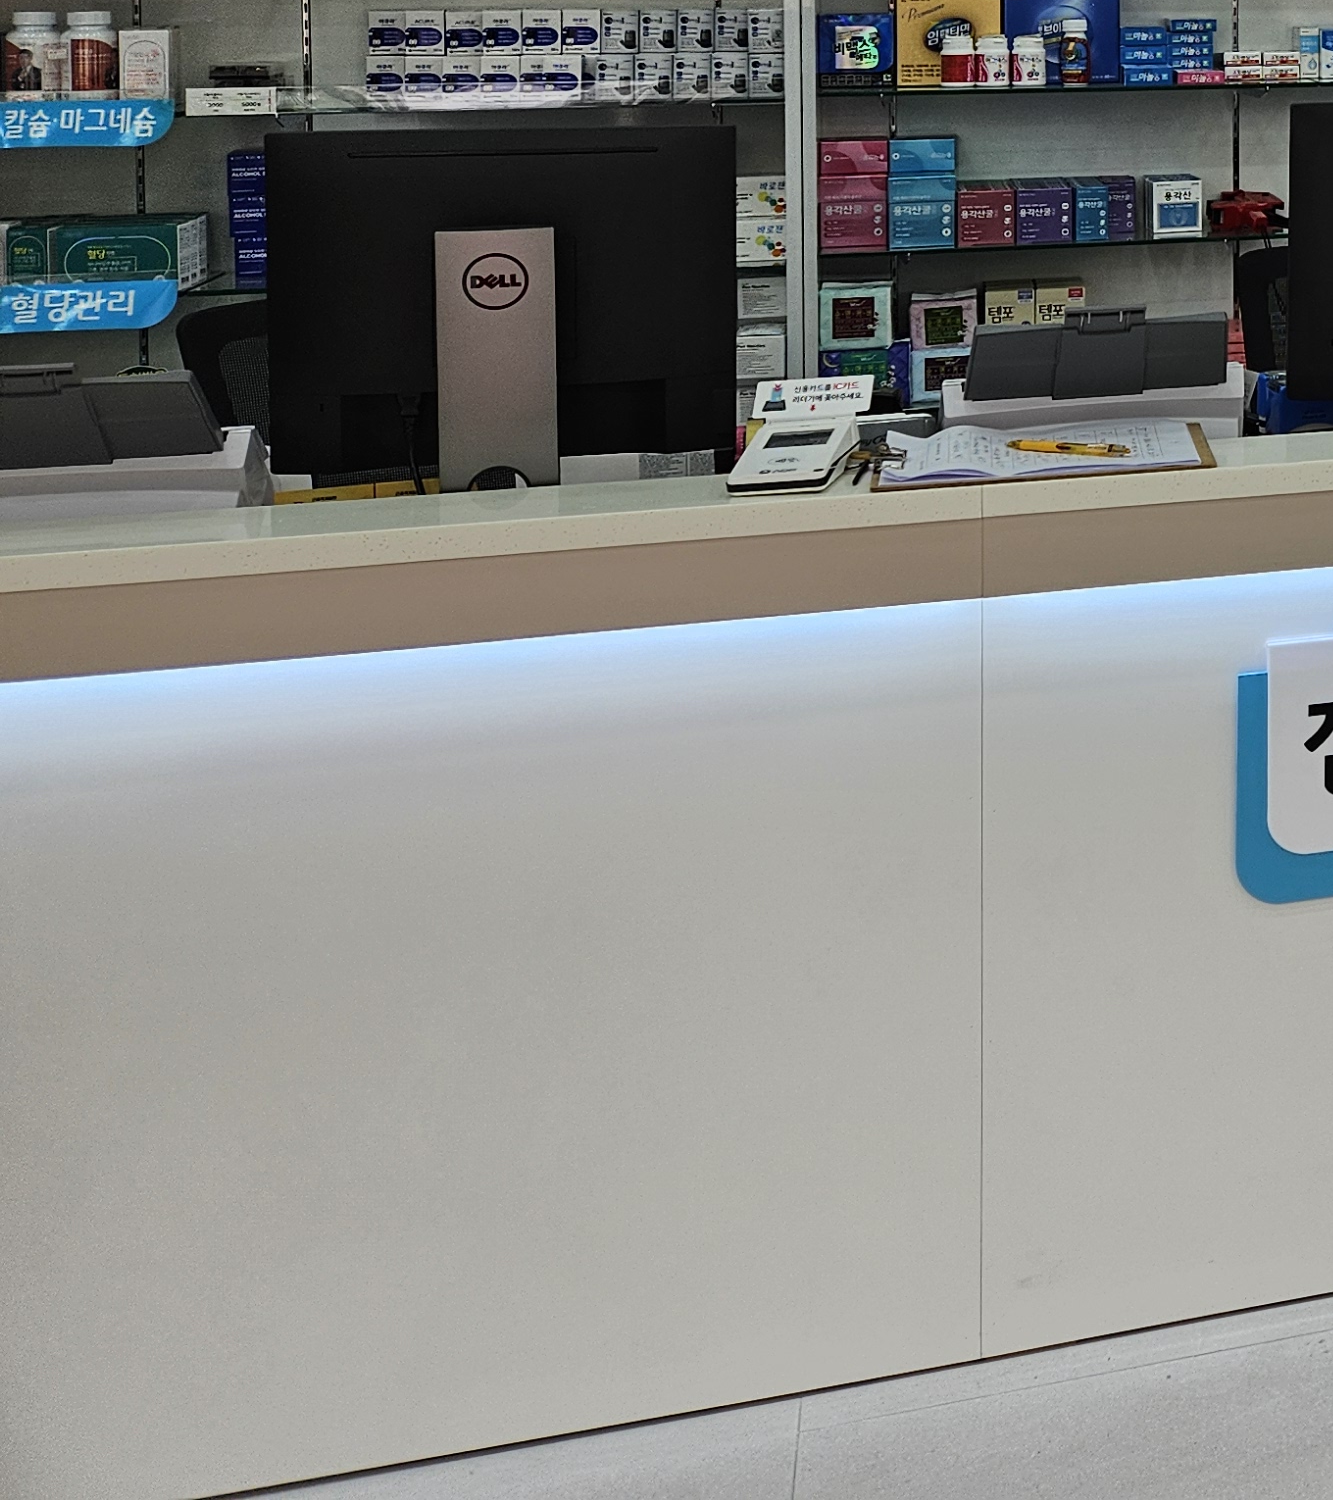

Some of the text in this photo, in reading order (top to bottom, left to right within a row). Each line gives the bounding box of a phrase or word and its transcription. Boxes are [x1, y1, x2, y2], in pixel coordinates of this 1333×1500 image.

[5, 108, 156, 139] 칼슘·마그네슘
[1164, 191, 1191, 201] 용각산
[470, 274, 522, 289] DELL
[12, 290, 136, 323] 혈당관리
[988, 305, 1015, 324] 템포
[1039, 304, 1065, 322] 템포
[794, 382, 859, 393] 신용카드를 IC카드
